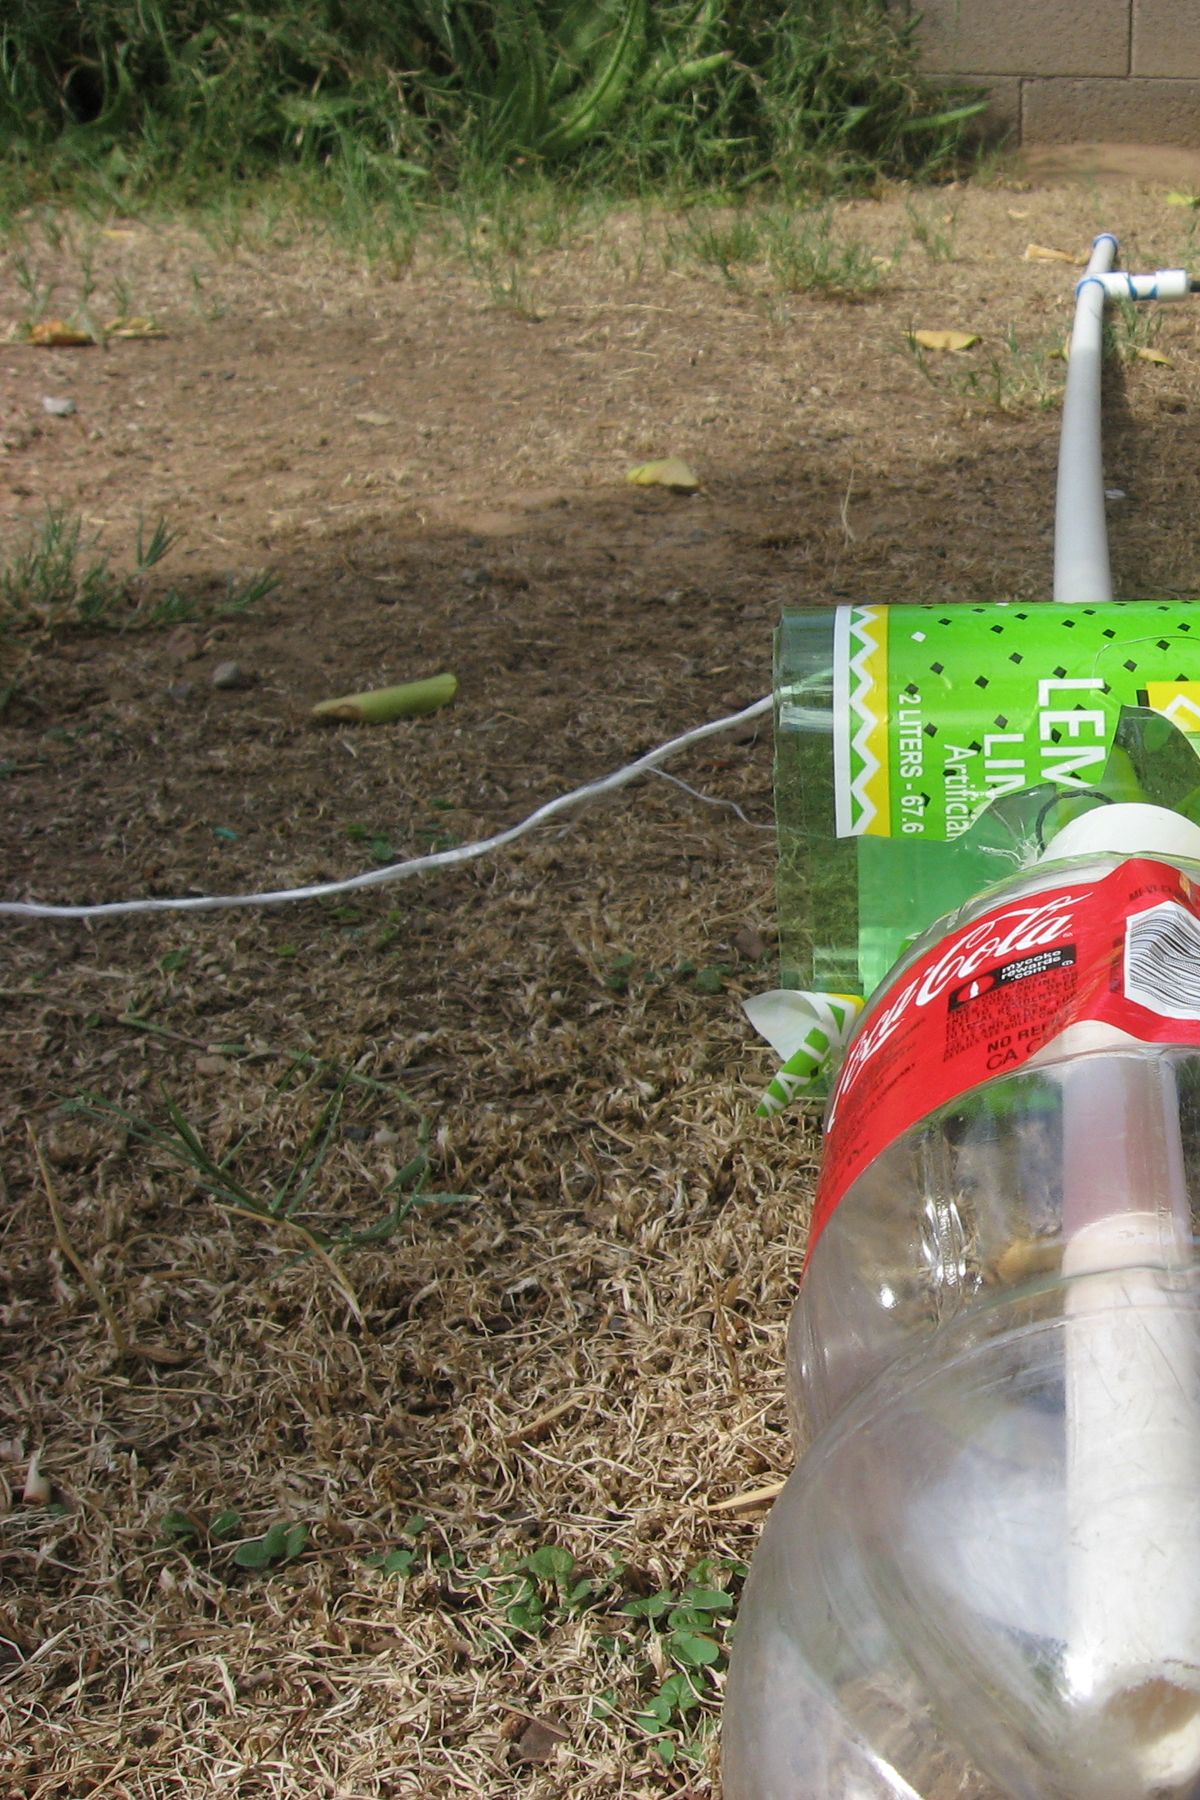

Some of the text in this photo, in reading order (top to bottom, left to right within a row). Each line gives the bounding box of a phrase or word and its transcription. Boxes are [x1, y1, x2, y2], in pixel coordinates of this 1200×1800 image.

[898, 693, 922, 705] 2
[899, 710, 923, 779] LITERS
[901, 796, 925, 834] 67.6
[1001, 956, 1061, 981] rewards
[1002, 950, 1062, 974] mycoke
[1010, 965, 1048, 982] .com
[987, 1035, 1012, 1053] NO
[986, 1048, 1018, 1071] CA
